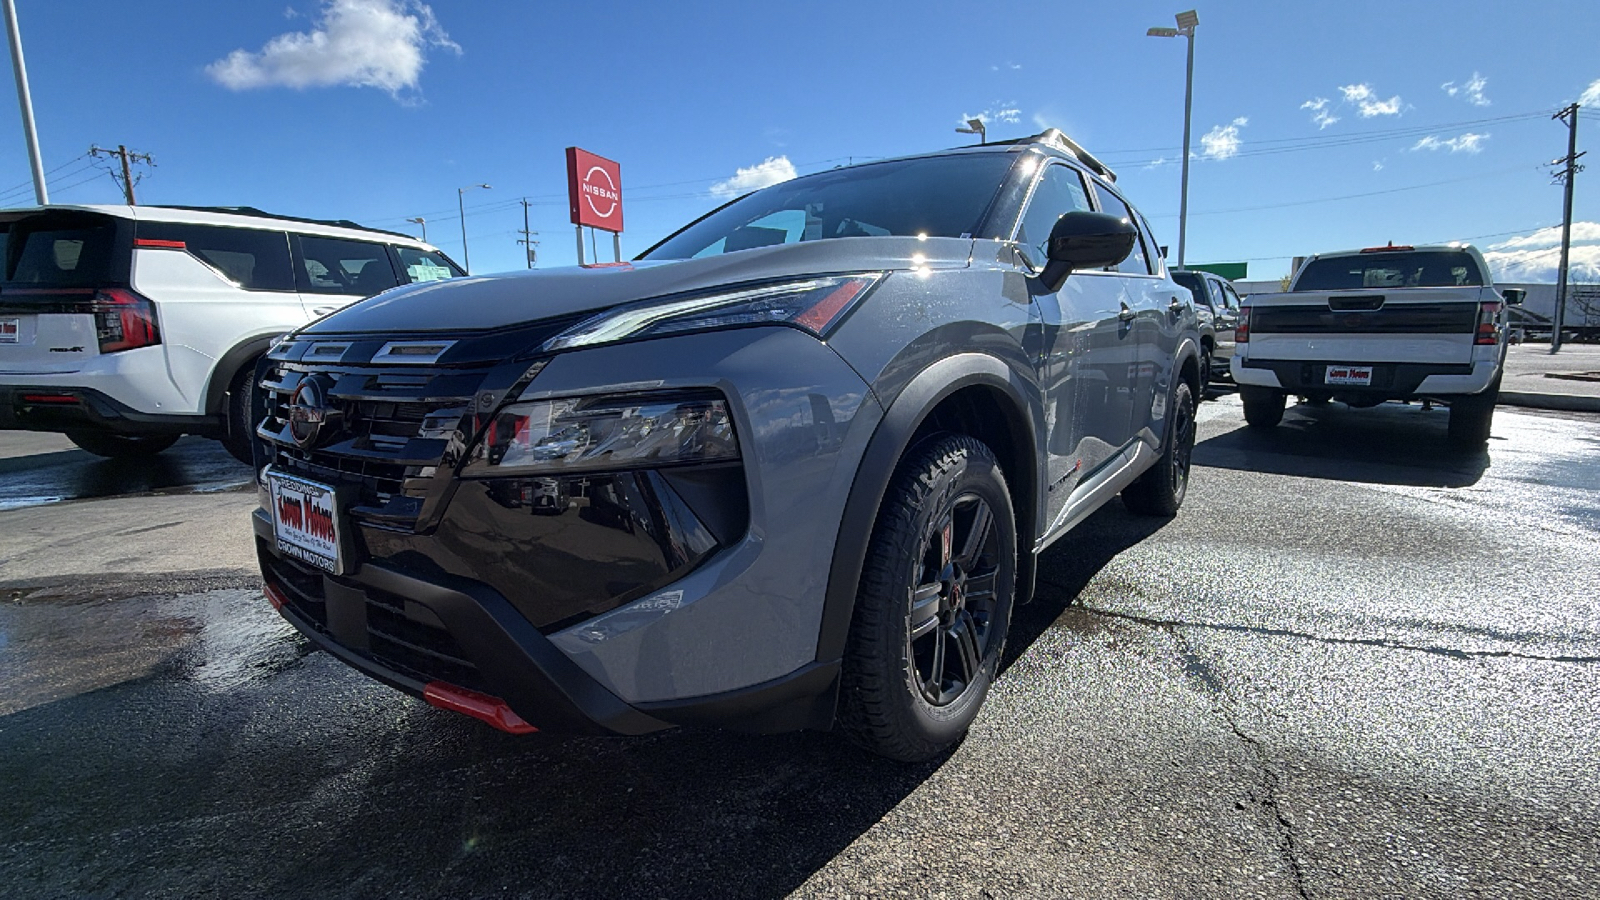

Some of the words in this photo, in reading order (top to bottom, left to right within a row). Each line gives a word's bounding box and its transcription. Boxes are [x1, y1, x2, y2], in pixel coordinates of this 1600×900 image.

[582, 182, 619, 201] NISSAN
[277, 540, 303, 558] CROWN
[303, 550, 335, 573] MOTORS
